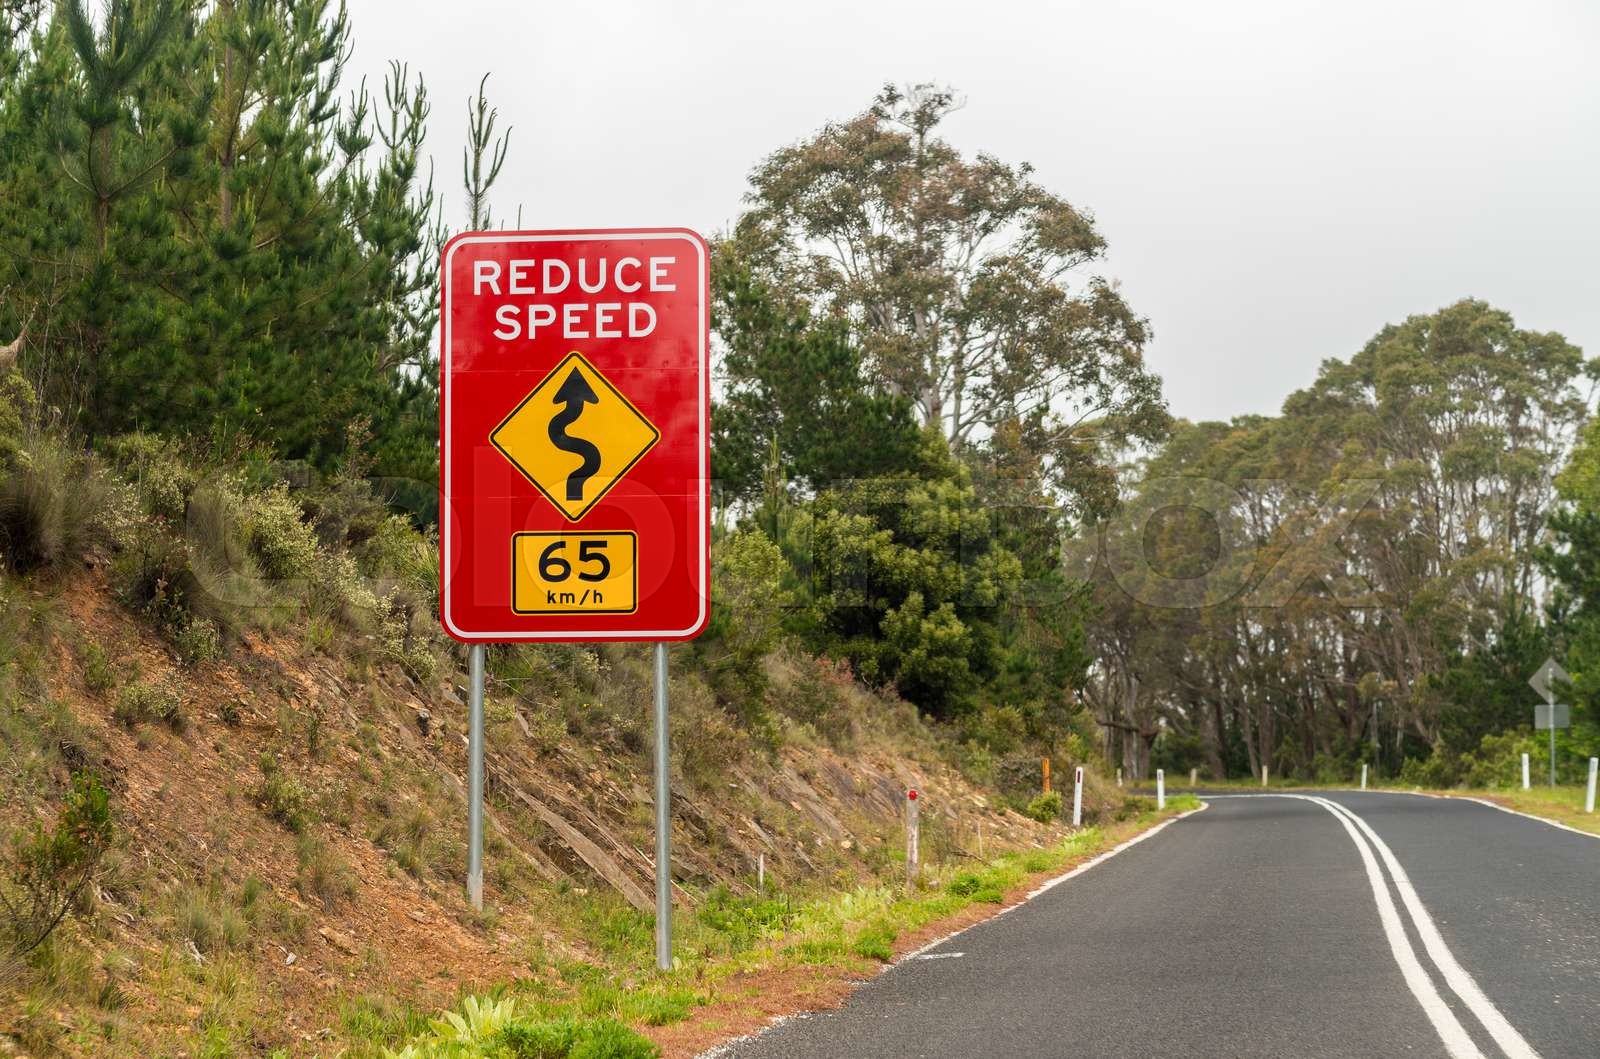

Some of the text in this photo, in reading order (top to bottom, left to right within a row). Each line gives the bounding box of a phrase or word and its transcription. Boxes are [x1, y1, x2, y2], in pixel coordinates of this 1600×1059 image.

[473, 256, 676, 296] REDUCE
[492, 302, 657, 340] SPEED
[538, 540, 611, 583] 65
[547, 589, 604, 606] km/h
